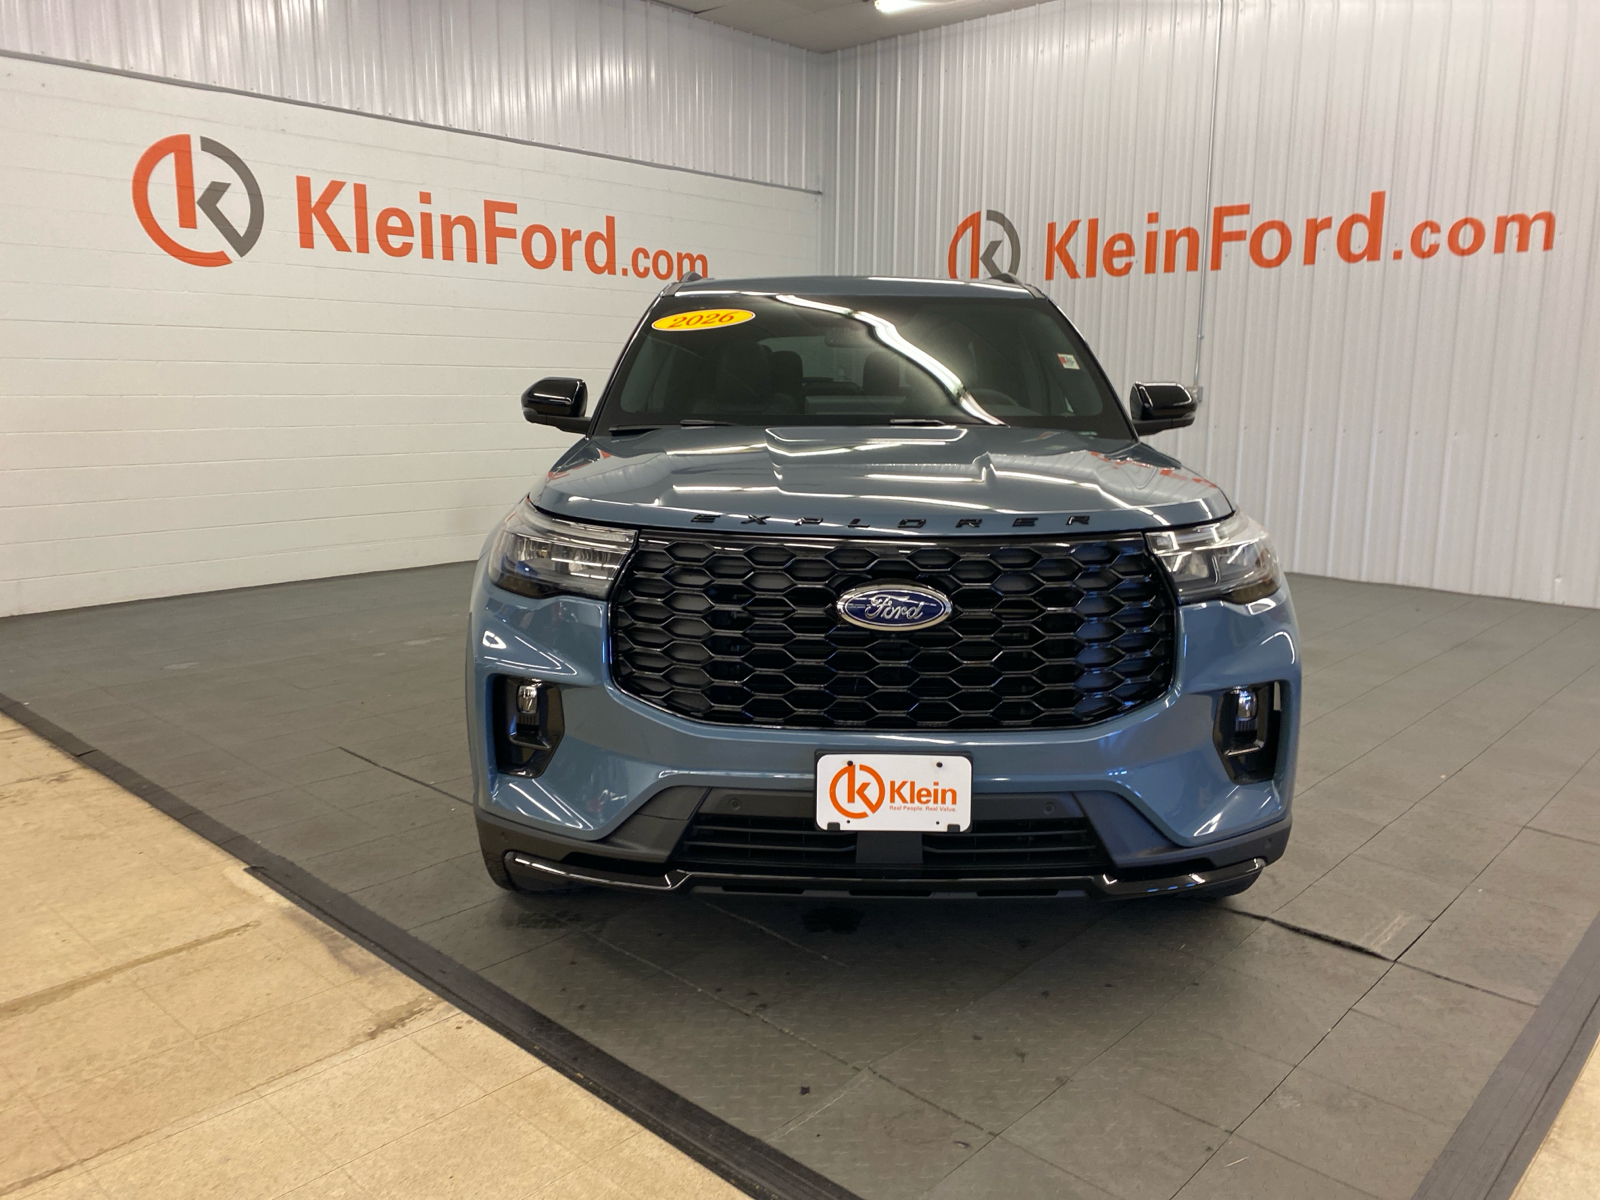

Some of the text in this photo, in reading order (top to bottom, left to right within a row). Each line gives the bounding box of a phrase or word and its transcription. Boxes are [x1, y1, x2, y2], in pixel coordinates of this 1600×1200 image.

[295, 174, 709, 282] KleinFord.com
[1044, 190, 1556, 281] KleinFord.com
[667, 311, 740, 329] 2026
[690, 513, 1092, 529] EXPLORER
[864, 594, 923, 620] Ford
[889, 780, 958, 805] Klein
